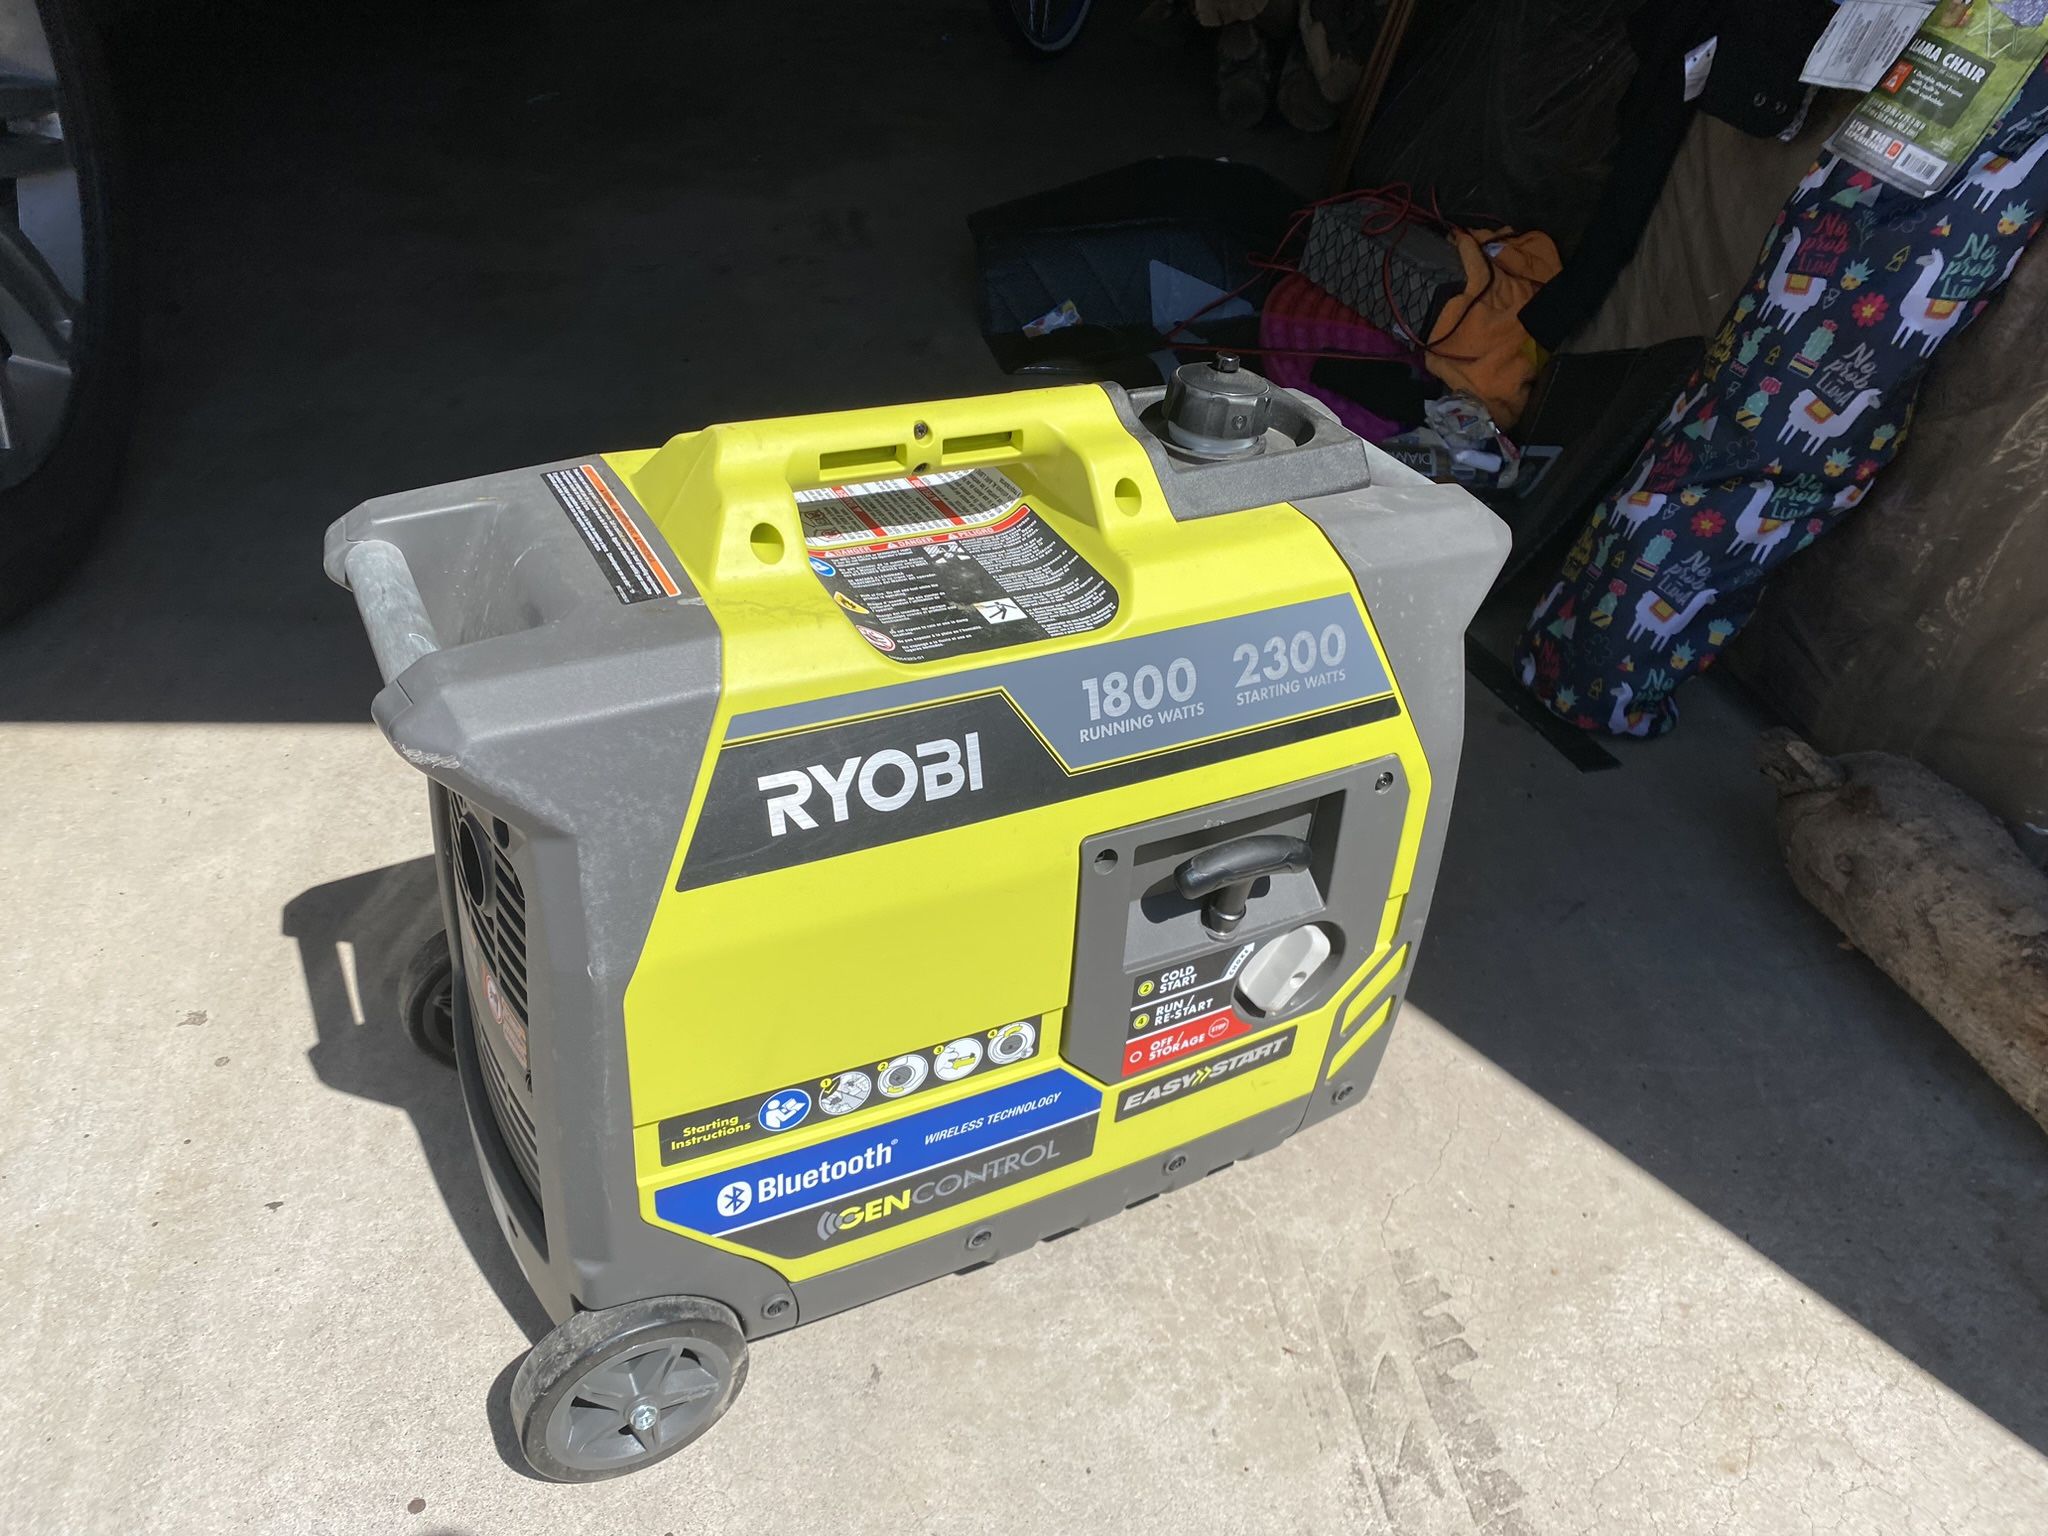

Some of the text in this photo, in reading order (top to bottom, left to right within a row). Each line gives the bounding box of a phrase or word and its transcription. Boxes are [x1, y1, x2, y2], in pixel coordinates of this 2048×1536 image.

[1942, 53, 1986, 82] CHAIR
[1953, 232, 2000, 261] No
[1939, 256, 1998, 279] prob
[1842, 342, 1876, 373] No
[1822, 359, 1877, 389] prob
[897, 538, 933, 548] DANGER
[959, 527, 994, 537] PELIGRO
[834, 546, 872, 557] DANGER
[1680, 550, 1712, 577] No
[1663, 563, 1708, 590] prob
[1082, 623, 1347, 721] 1800 2300
[1642, 668, 1675, 691] No
[1236, 669, 1346, 706] STARTING WATTS
[1079, 702, 1205, 743] RUNNING WATTS
[757, 731, 983, 837] RYOBI
[1159, 974, 1197, 994] START
[1160, 965, 1195, 984] COLD
[1154, 998, 1213, 1026] RE-START
[1155, 999, 1184, 1017] RUN
[1148, 1034, 1205, 1061] STORAGE
[1150, 1037, 1173, 1051] OFF
[1211, 1022, 1226, 1034] STOP
[1123, 1036, 1289, 1111] EASY START
[683, 1115, 740, 1138] Starting
[924, 1091, 1062, 1147] WIRELESS TECHNOLOGY
[671, 1122, 751, 1152] Instructions
[835, 1140, 1060, 1233] GENCONTROL
